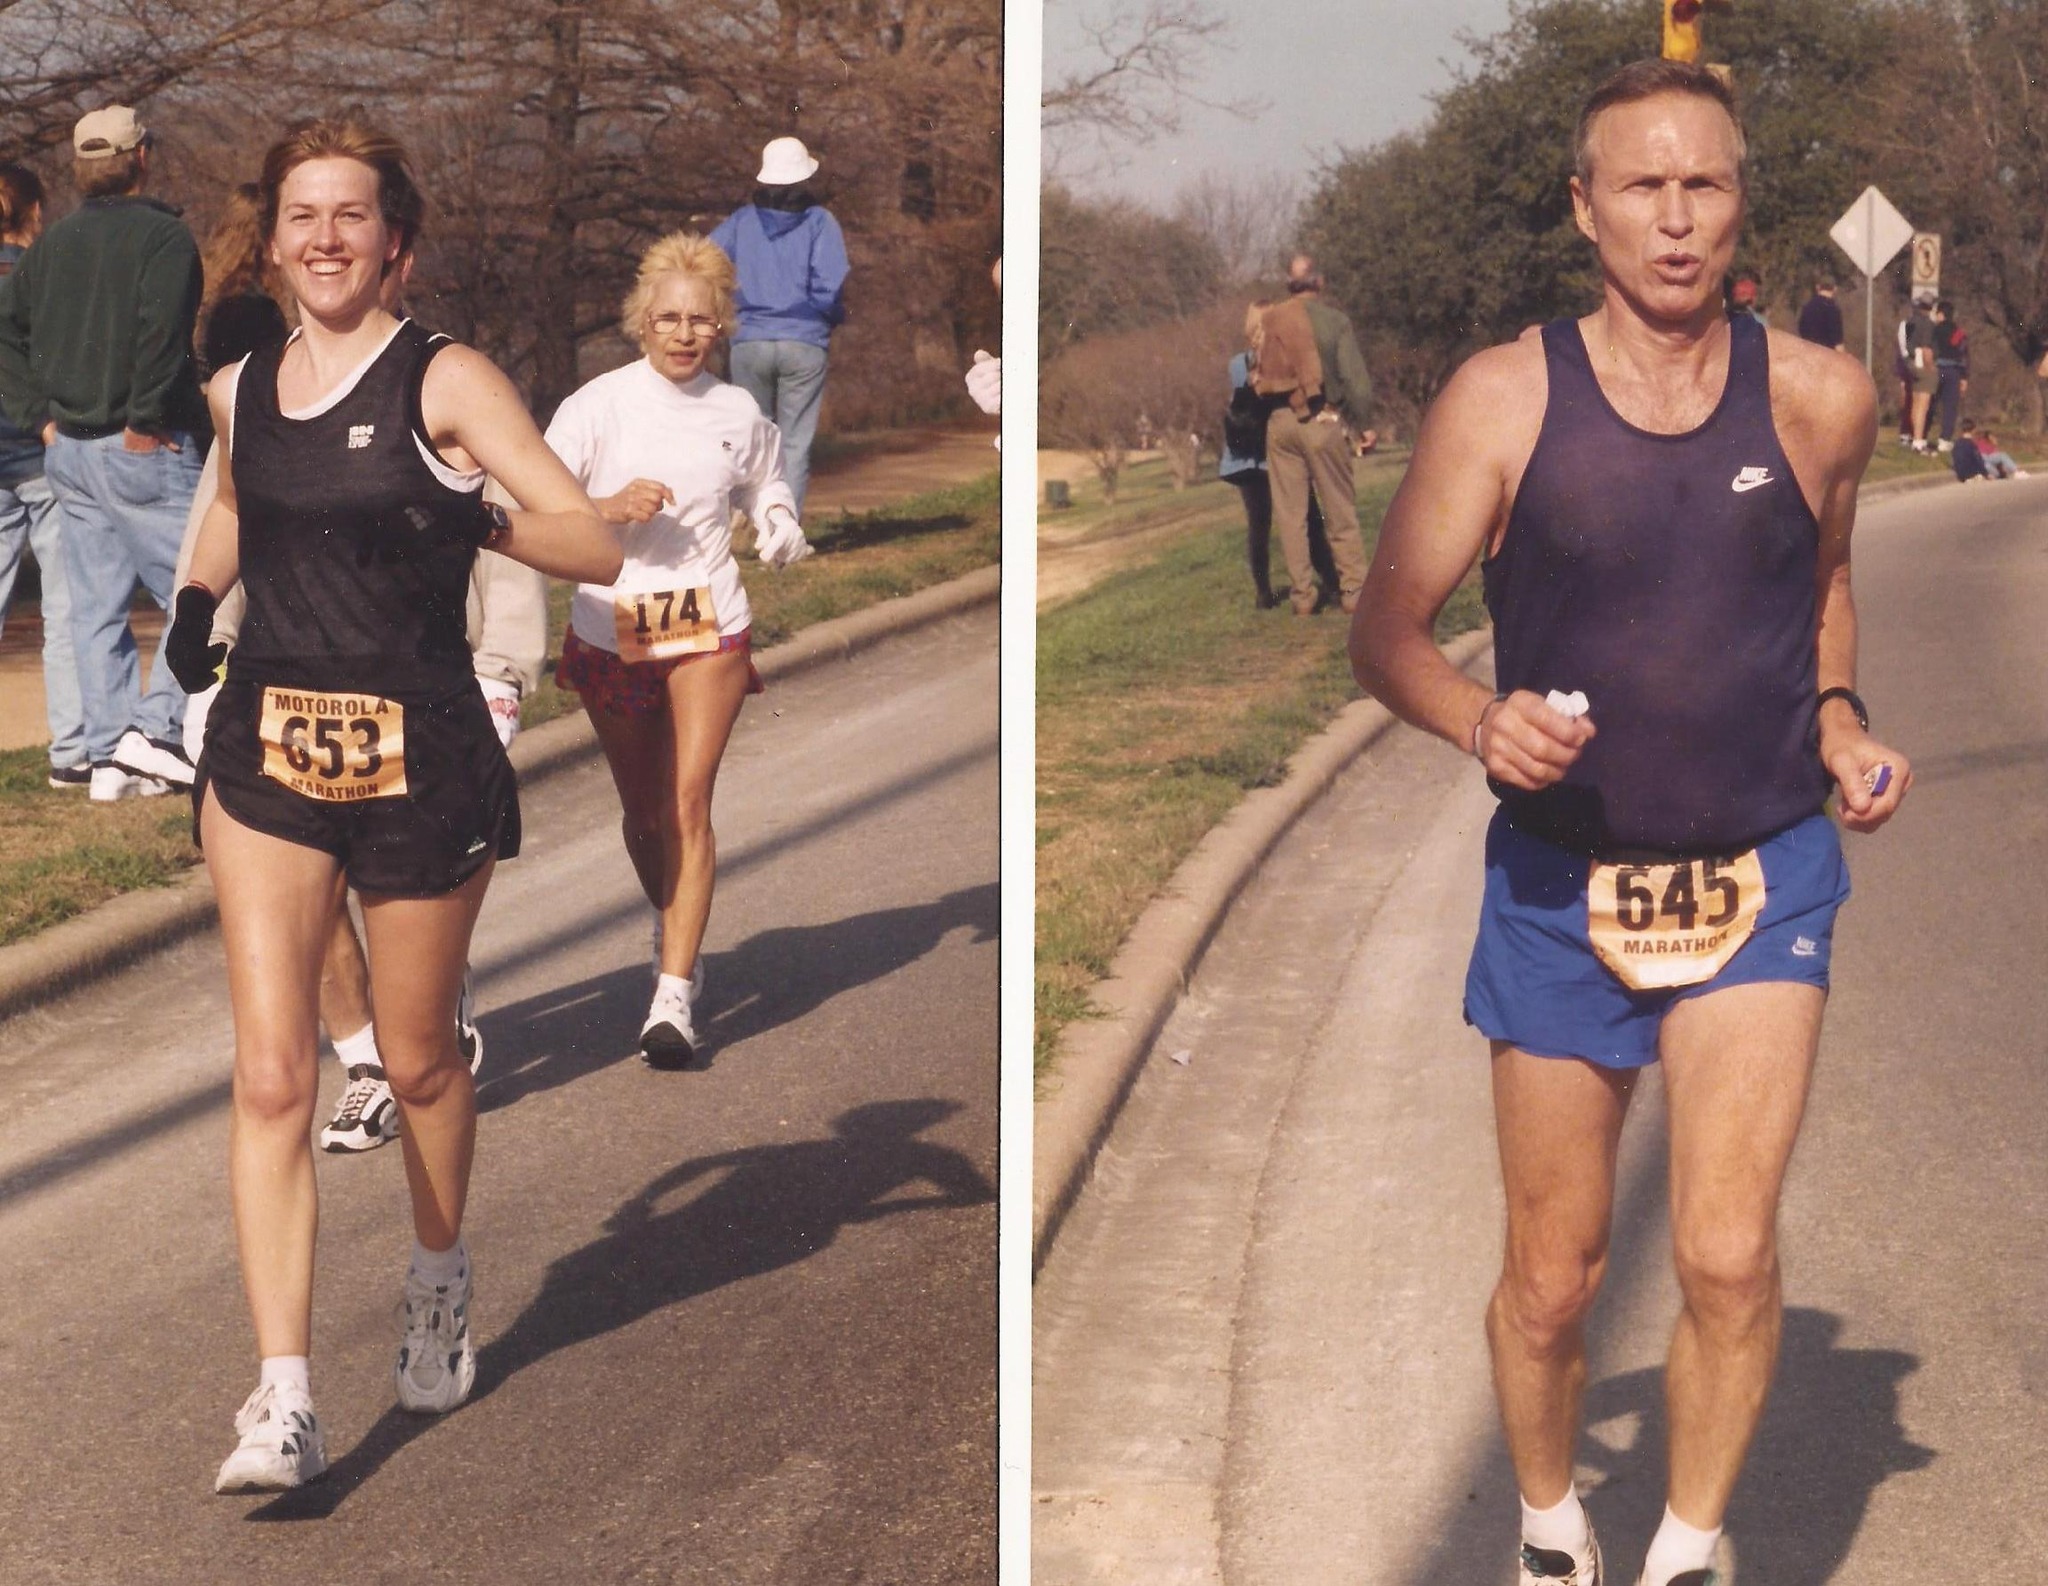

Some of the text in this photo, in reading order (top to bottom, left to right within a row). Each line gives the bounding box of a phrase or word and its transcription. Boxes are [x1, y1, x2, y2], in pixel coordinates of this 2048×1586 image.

[635, 588, 702, 633] 174
[275, 693, 389, 716] MOTOROLA
[280, 715, 383, 780] 653
[290, 777, 379, 800] MARATHON
[1616, 856, 1739, 931] 645
[1624, 930, 1729, 955] MARATHON
